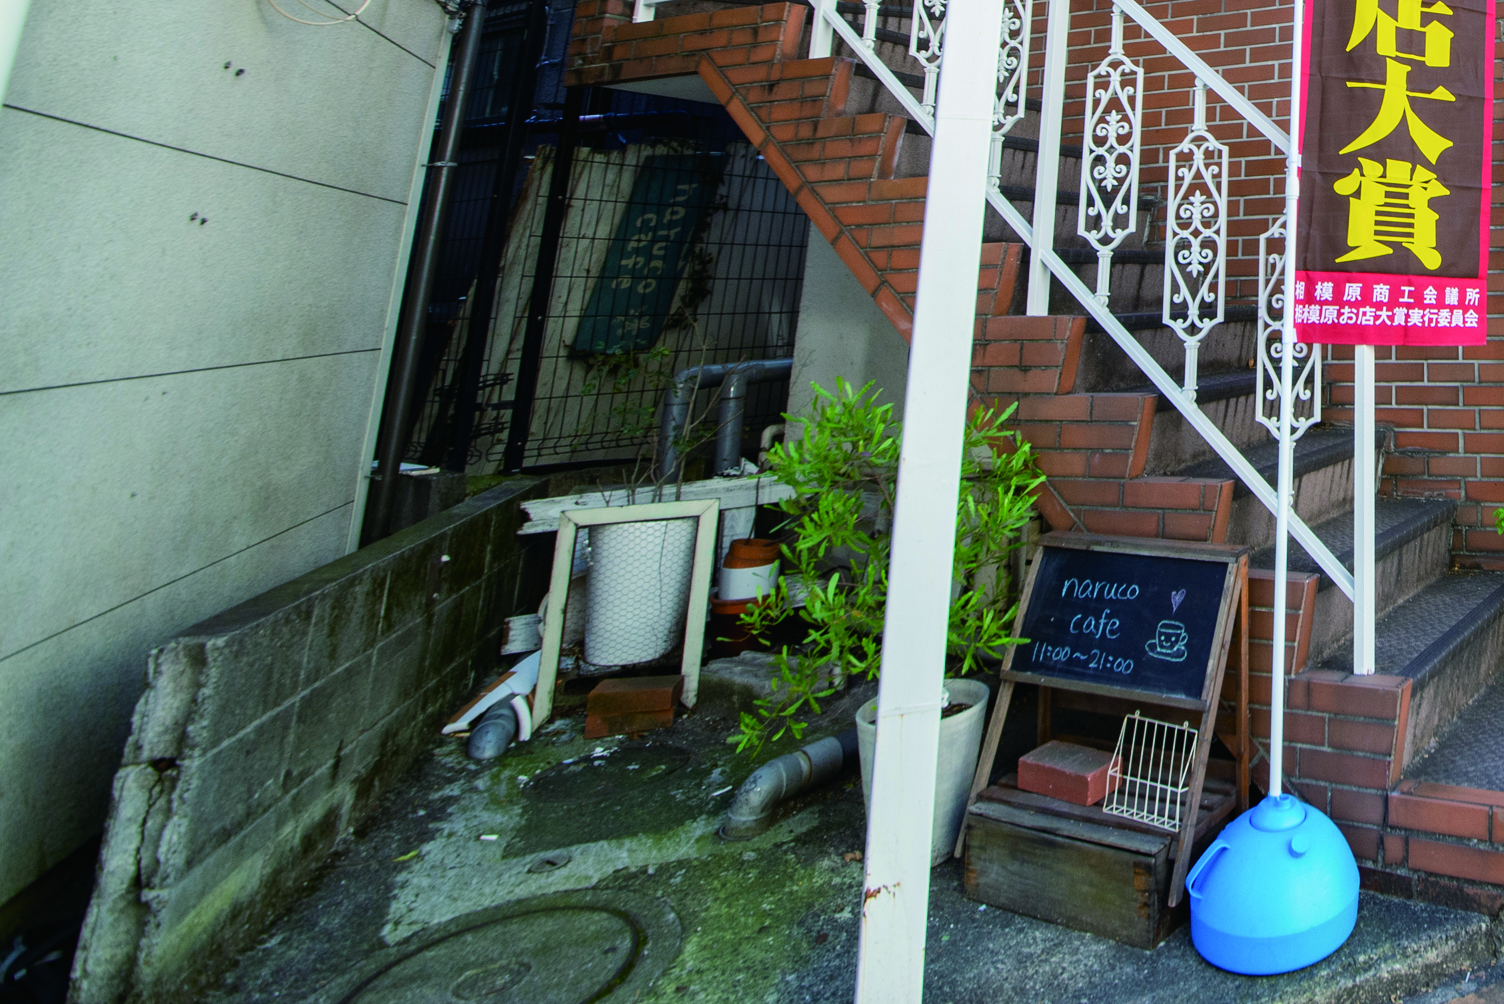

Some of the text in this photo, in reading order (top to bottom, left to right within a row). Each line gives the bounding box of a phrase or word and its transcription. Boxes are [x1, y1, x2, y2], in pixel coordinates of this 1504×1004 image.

[1295, 280, 1480, 306] 相模原商工会議所
[1061, 576, 1140, 601] naruco
[1069, 608, 1121, 640] cafe
